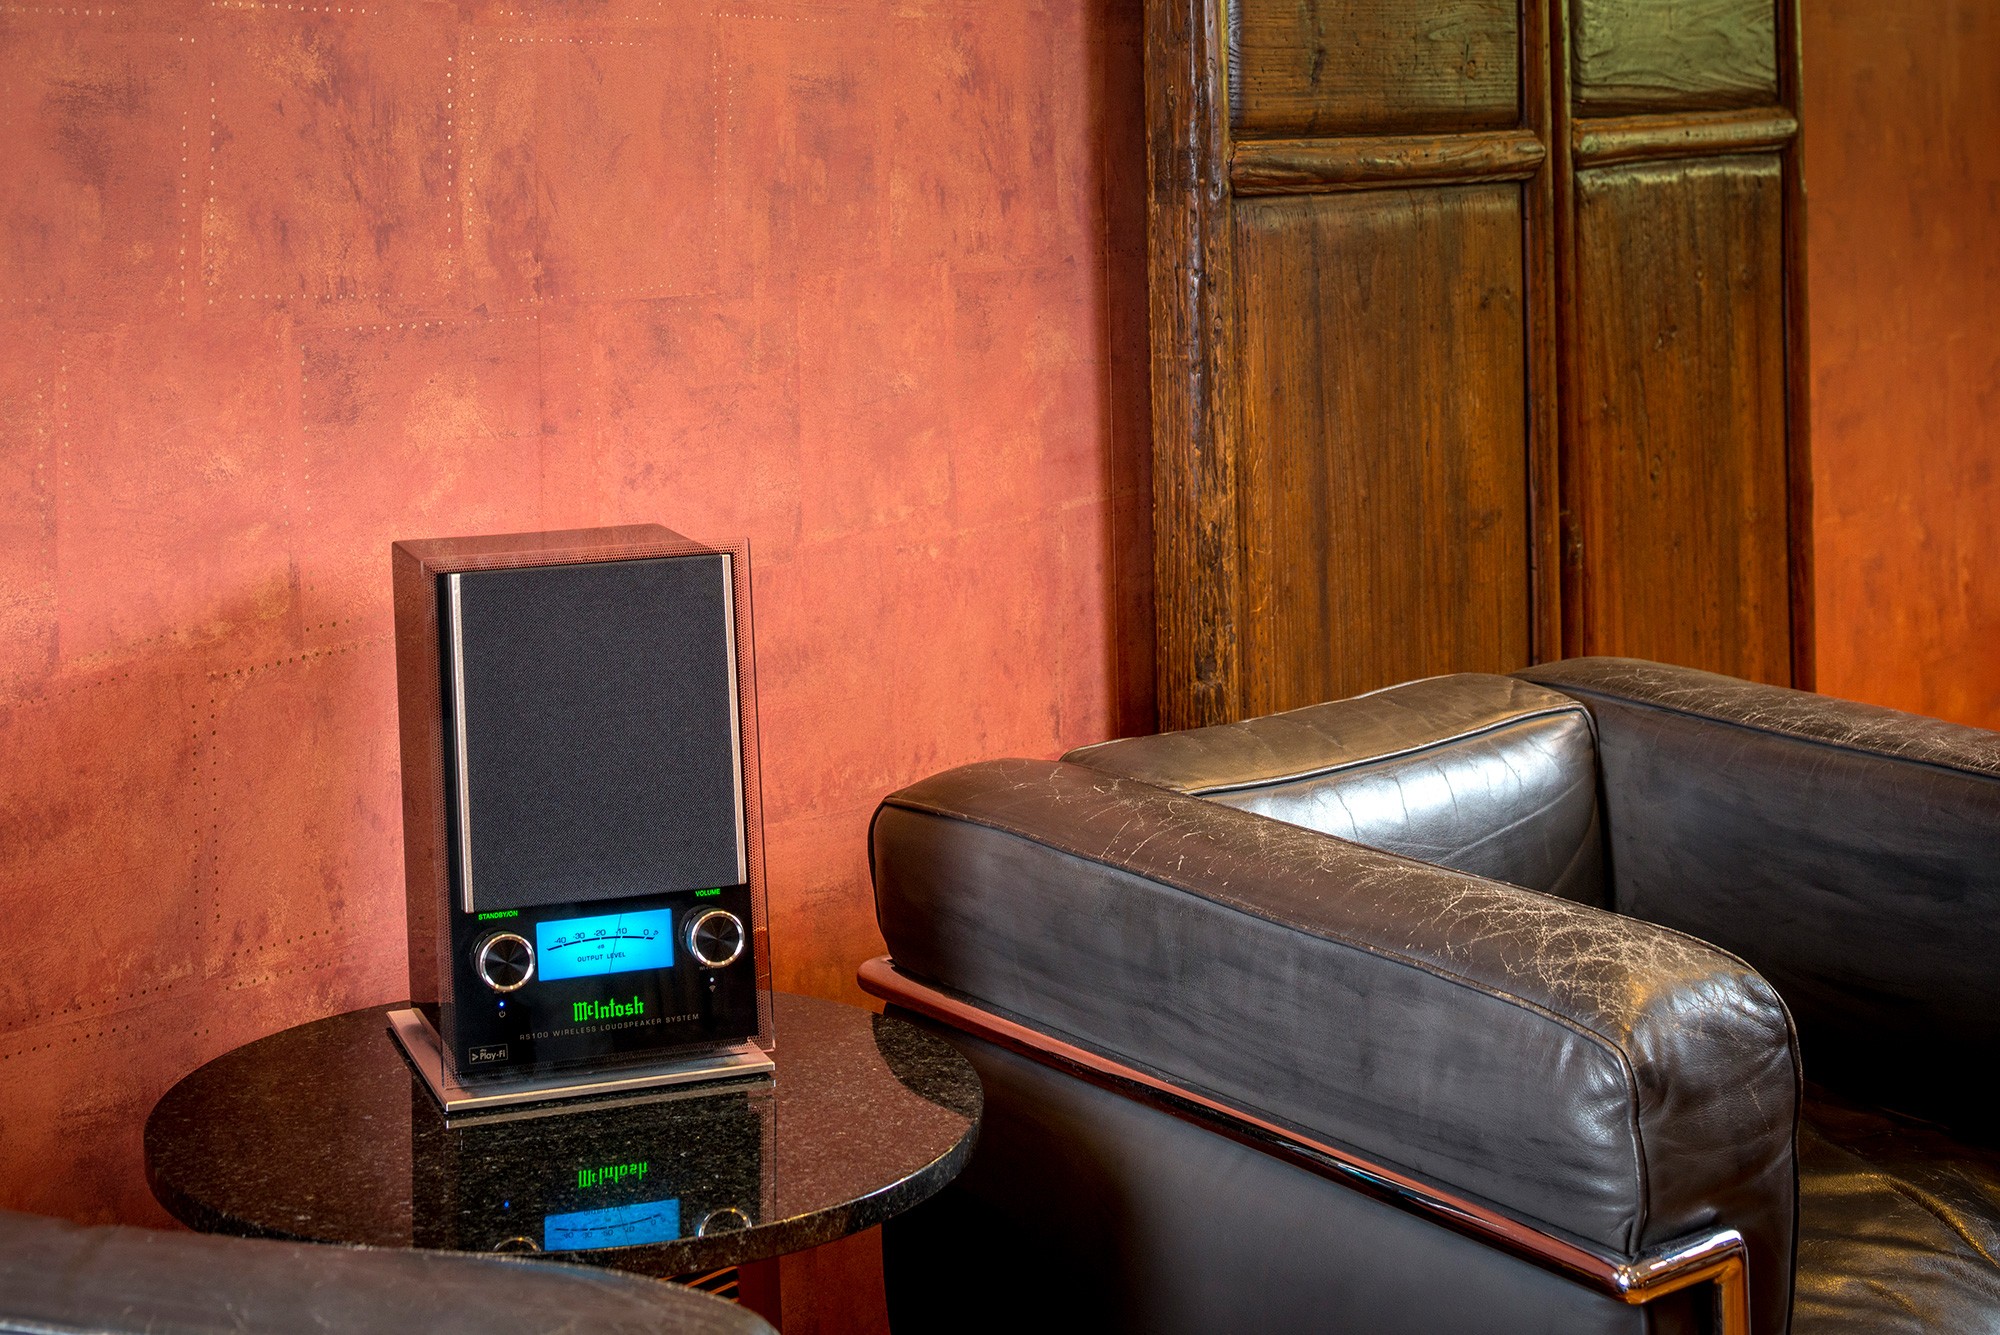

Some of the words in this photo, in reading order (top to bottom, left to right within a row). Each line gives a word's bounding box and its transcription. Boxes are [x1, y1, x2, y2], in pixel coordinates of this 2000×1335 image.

[695, 888, 721, 897] VOLUME
[478, 910, 519, 921] STANDBY/ON
[554, 936, 567, 944] -40
[573, 932, 586, 940] -30
[594, 929, 607, 937] -20
[643, 928, 650, 936] 0
[577, 954, 603, 963] OUTPUT
[606, 952, 626, 960] LEVEL
[573, 995, 645, 1022] McIntosh
[519, 1031, 549, 1041] RS100
[552, 1025, 597, 1037] WIRELESS
[600, 1018, 662, 1032] LOUDSPEAKER
[665, 1013, 700, 1024] SYSTEM
